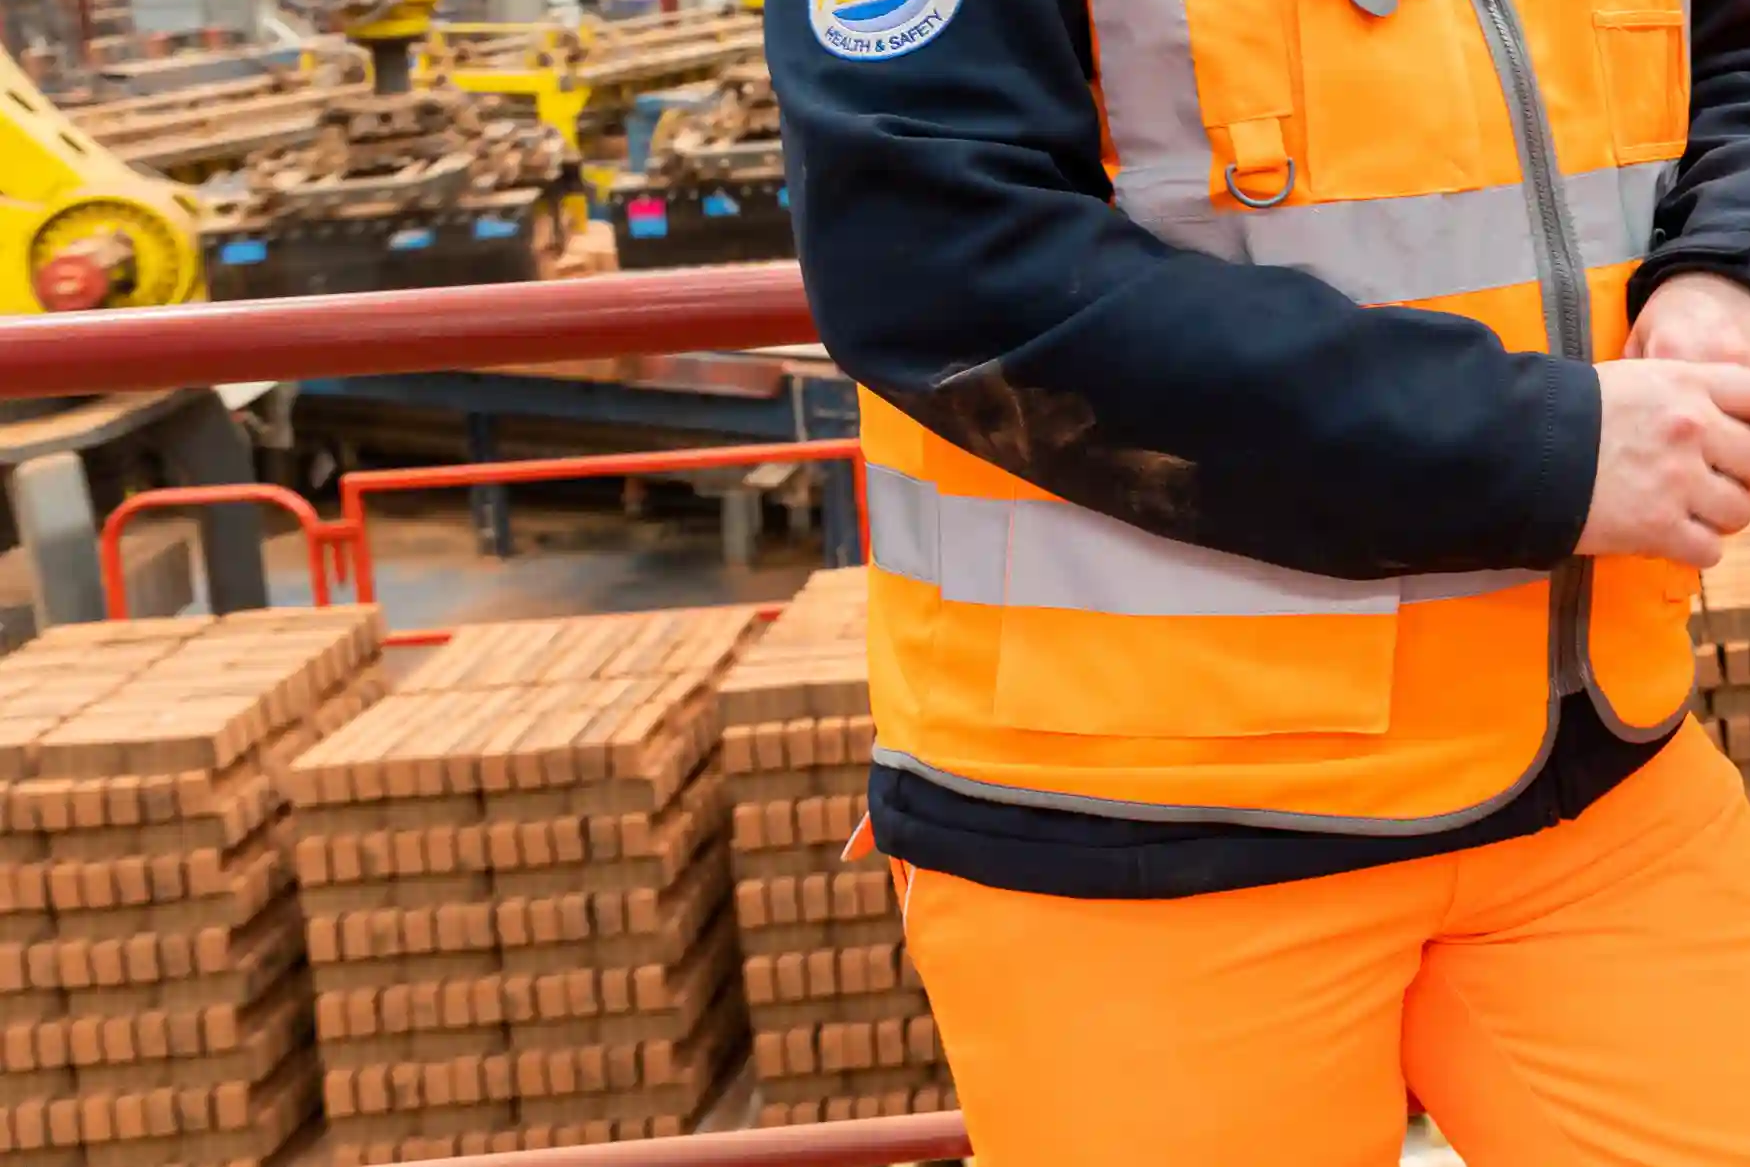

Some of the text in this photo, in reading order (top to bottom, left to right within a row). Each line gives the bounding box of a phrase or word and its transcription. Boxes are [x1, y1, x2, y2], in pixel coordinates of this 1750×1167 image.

[825, 9, 944, 52] HEALTH & SAFETY
